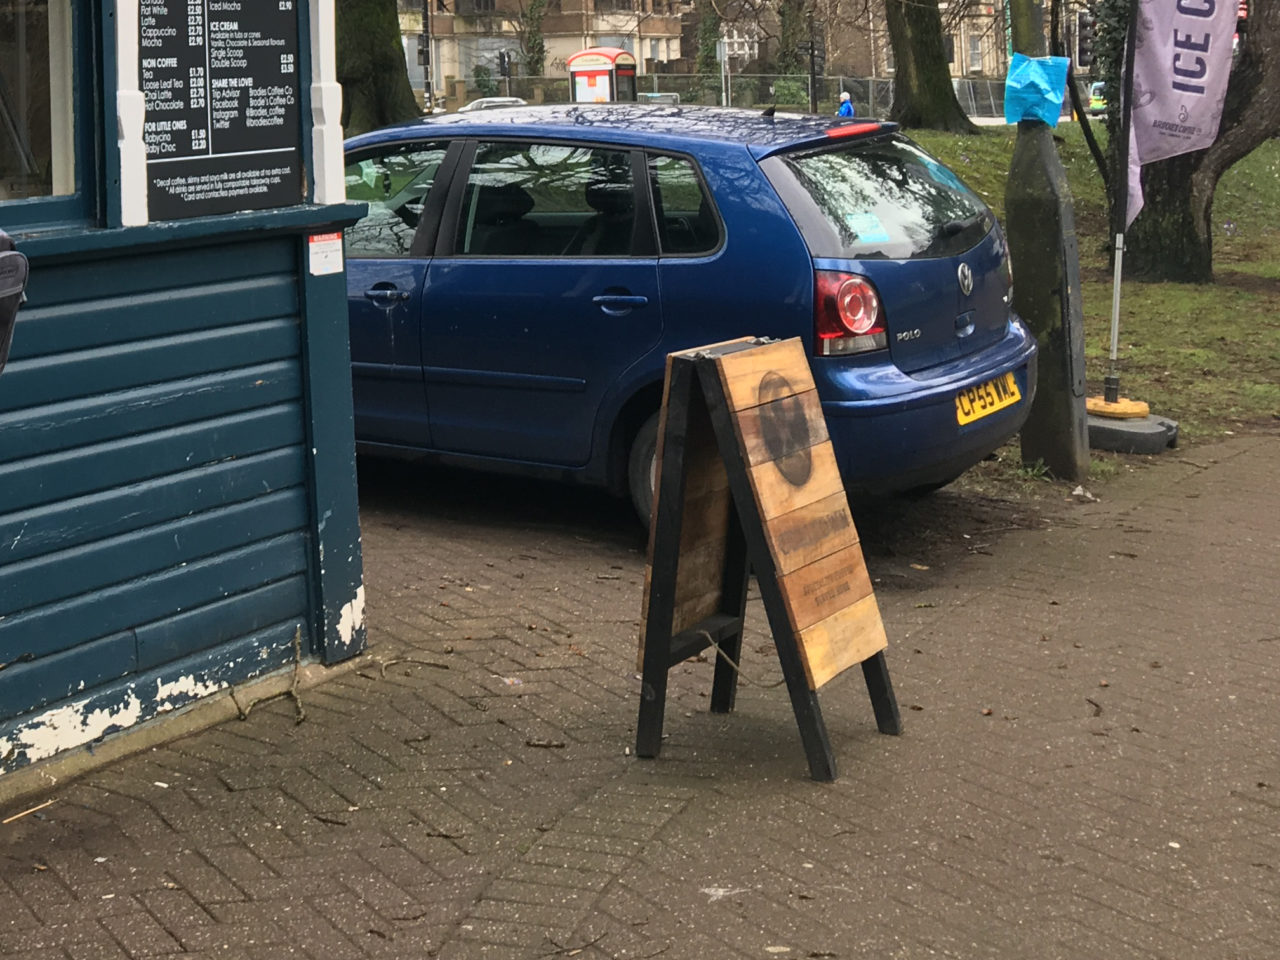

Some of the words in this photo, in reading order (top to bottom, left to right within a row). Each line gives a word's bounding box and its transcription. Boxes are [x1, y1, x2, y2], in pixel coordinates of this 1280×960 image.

[141, 6, 151, 15] Flat
[152, 6, 168, 15] White
[209, 1, 221, 10] Iced
[222, 1, 241, 10] Mocha
[141, 16, 155, 26] Latte
[210, 21, 219, 31] ICE
[220, 21, 238, 31] CREAM
[141, 26, 176, 38] Cappuccino
[142, 37, 162, 47] Mocha
[211, 48, 226, 59] Single
[227, 48, 243, 58] Scoop
[142, 58, 156, 68] NON
[157, 58, 177, 67] COFFEE
[211, 58, 229, 68] Double
[230, 58, 247, 68] Scoop
[1172, 28, 1210, 94] ICE
[142, 69, 153, 79] Tea
[143, 80, 159, 89] Loose
[160, 79, 172, 88] Leaf
[173, 79, 183, 88] Tea
[212, 78, 228, 88] SHARE
[229, 78, 237, 87] THE
[158, 90, 172, 99] Latte
[222, 89, 240, 98] Advisor
[267, 86, 284, 95] Coffee
[285, 85, 293, 95] Co
[155, 100, 184, 110] Chocolate
[212, 98, 238, 109] Facebook
[269, 96, 286, 105] Coffee
[287, 95, 294, 104] Co
[213, 110, 239, 121] Instagram
[144, 122, 156, 132] FOR
[156, 121, 171, 131] LITTLE
[172, 120, 187, 130] ONES
[213, 120, 230, 129] Twitter
[160, 142, 176, 152] Choc
[896, 329, 921, 342] POLO
[958, 381, 994, 416] CP55
